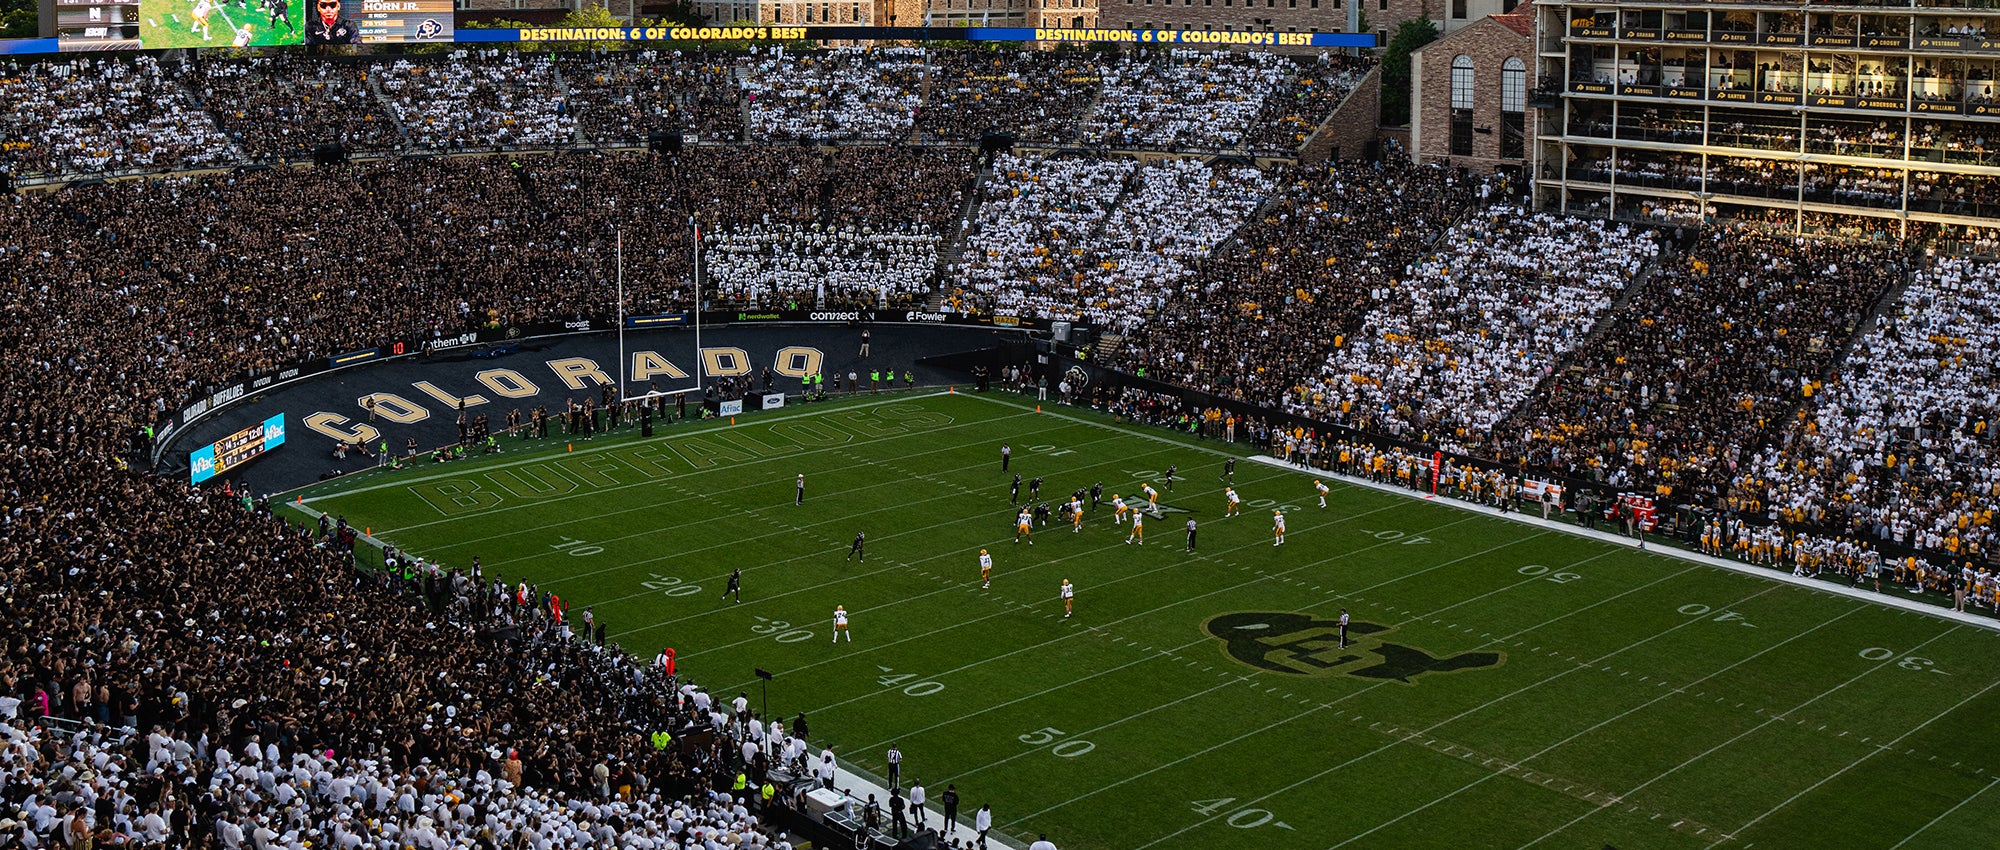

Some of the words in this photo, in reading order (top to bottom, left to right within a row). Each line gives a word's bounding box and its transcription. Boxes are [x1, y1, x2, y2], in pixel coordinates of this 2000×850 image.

[364, 3, 400, 11] HORN
[402, 2, 420, 11] JR.
[520, 28, 626, 41] DESTINATION:
[629, 28, 641, 40] 6
[645, 28, 667, 40] OF
[670, 27, 768, 40] COLORADO'S
[771, 27, 807, 40] BEST
[1035, 29, 1138, 43] DESTINATION:
[1141, 30, 1153, 41] 6
[1156, 30, 1178, 42] OF
[1181, 31, 1275, 45] COLORADO'S
[1278, 33, 1314, 46] BEST
[1930, 104, 1957, 112] WILLIAMS
[810, 311, 860, 321] connect
[915, 311, 947, 322] Fowler
[393, 342, 405, 355] 10
[212, 382, 245, 408] BUFFALOES
[302, 346, 825, 445] COLORADO
[720, 403, 742, 414] Aflac
[190, 456, 215, 477] Aflac
[408, 405, 954, 515] BUFFALOES
[549, 539, 605, 557] 10
[1516, 564, 1582, 584] 50
[640, 575, 702, 597] 20
[750, 621, 814, 643] 30
[876, 673, 945, 697] 40
[1018, 726, 1096, 758] 50
[1190, 797, 1275, 829] 40
